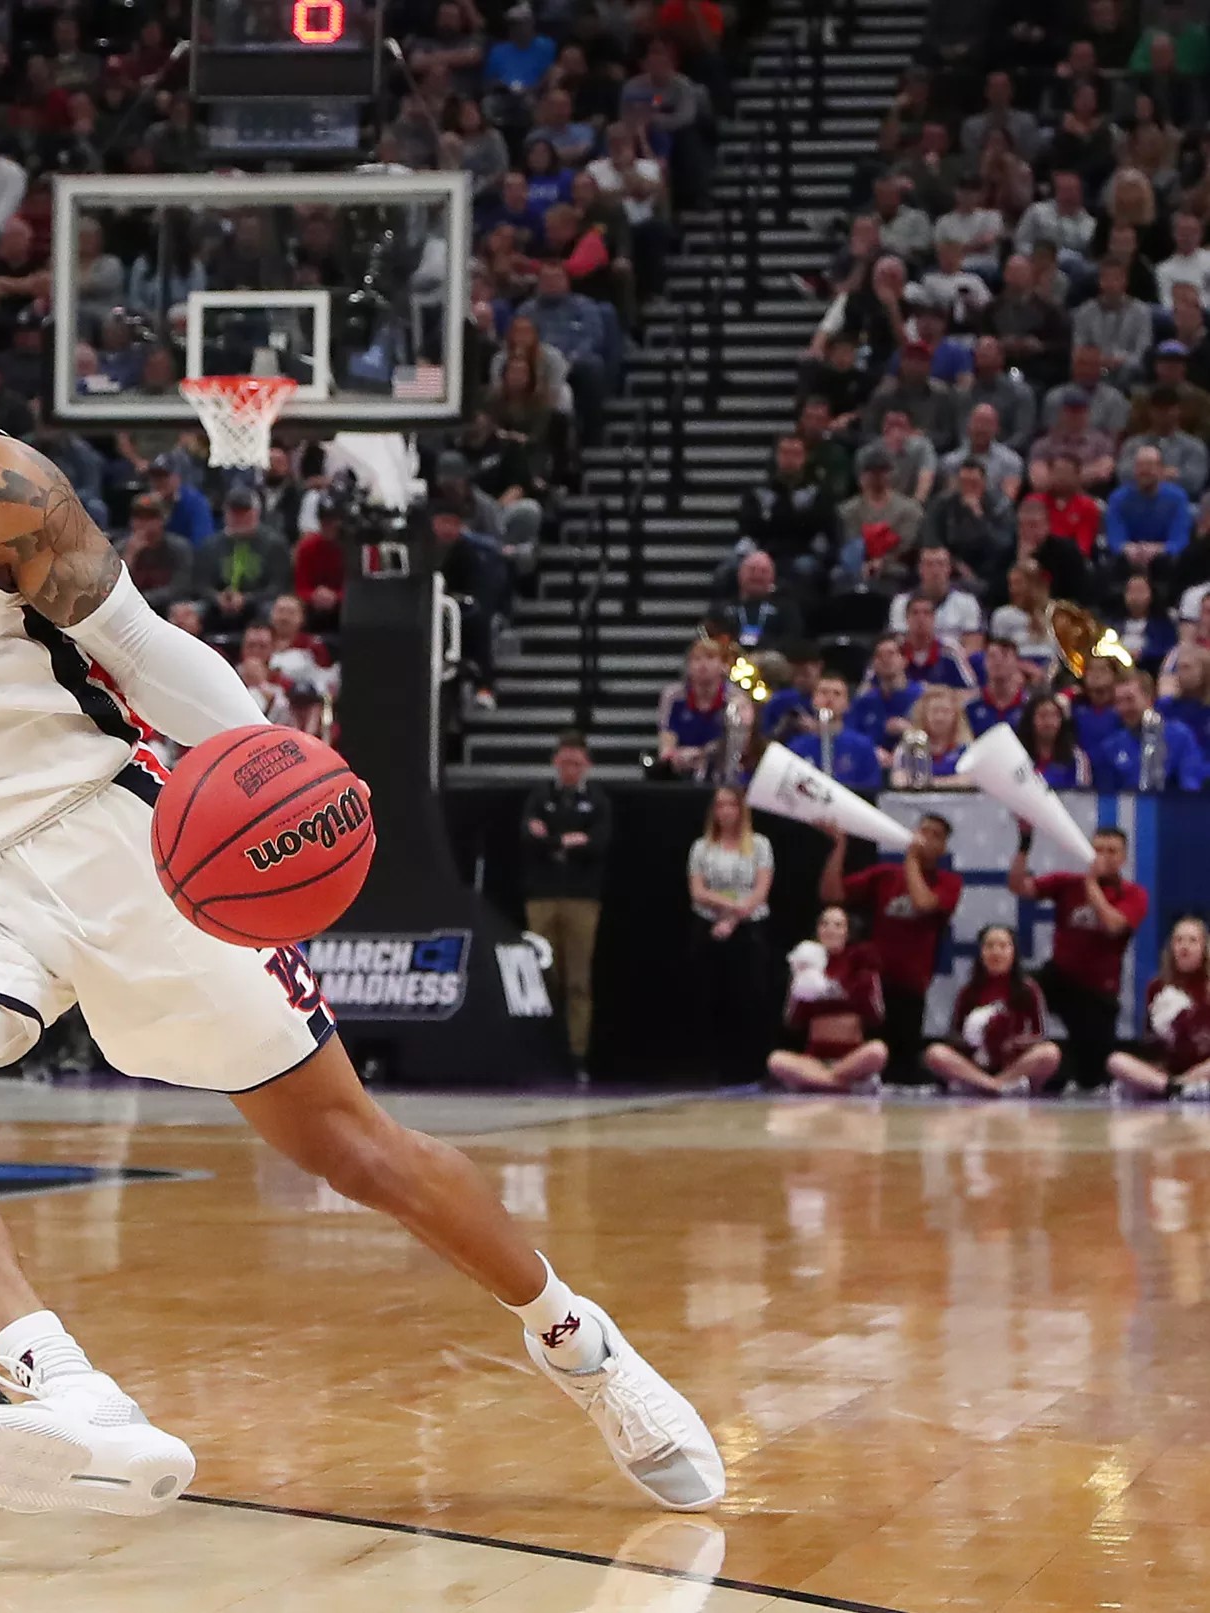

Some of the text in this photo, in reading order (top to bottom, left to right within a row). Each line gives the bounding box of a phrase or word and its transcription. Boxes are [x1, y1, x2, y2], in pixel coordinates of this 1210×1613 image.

[293, 0, 344, 43] 0
[257, 753, 297, 786] MARCH
[245, 786, 369, 871] Wilson
[307, 940, 415, 974] MARCH
[320, 972, 462, 1006] MADNESS
